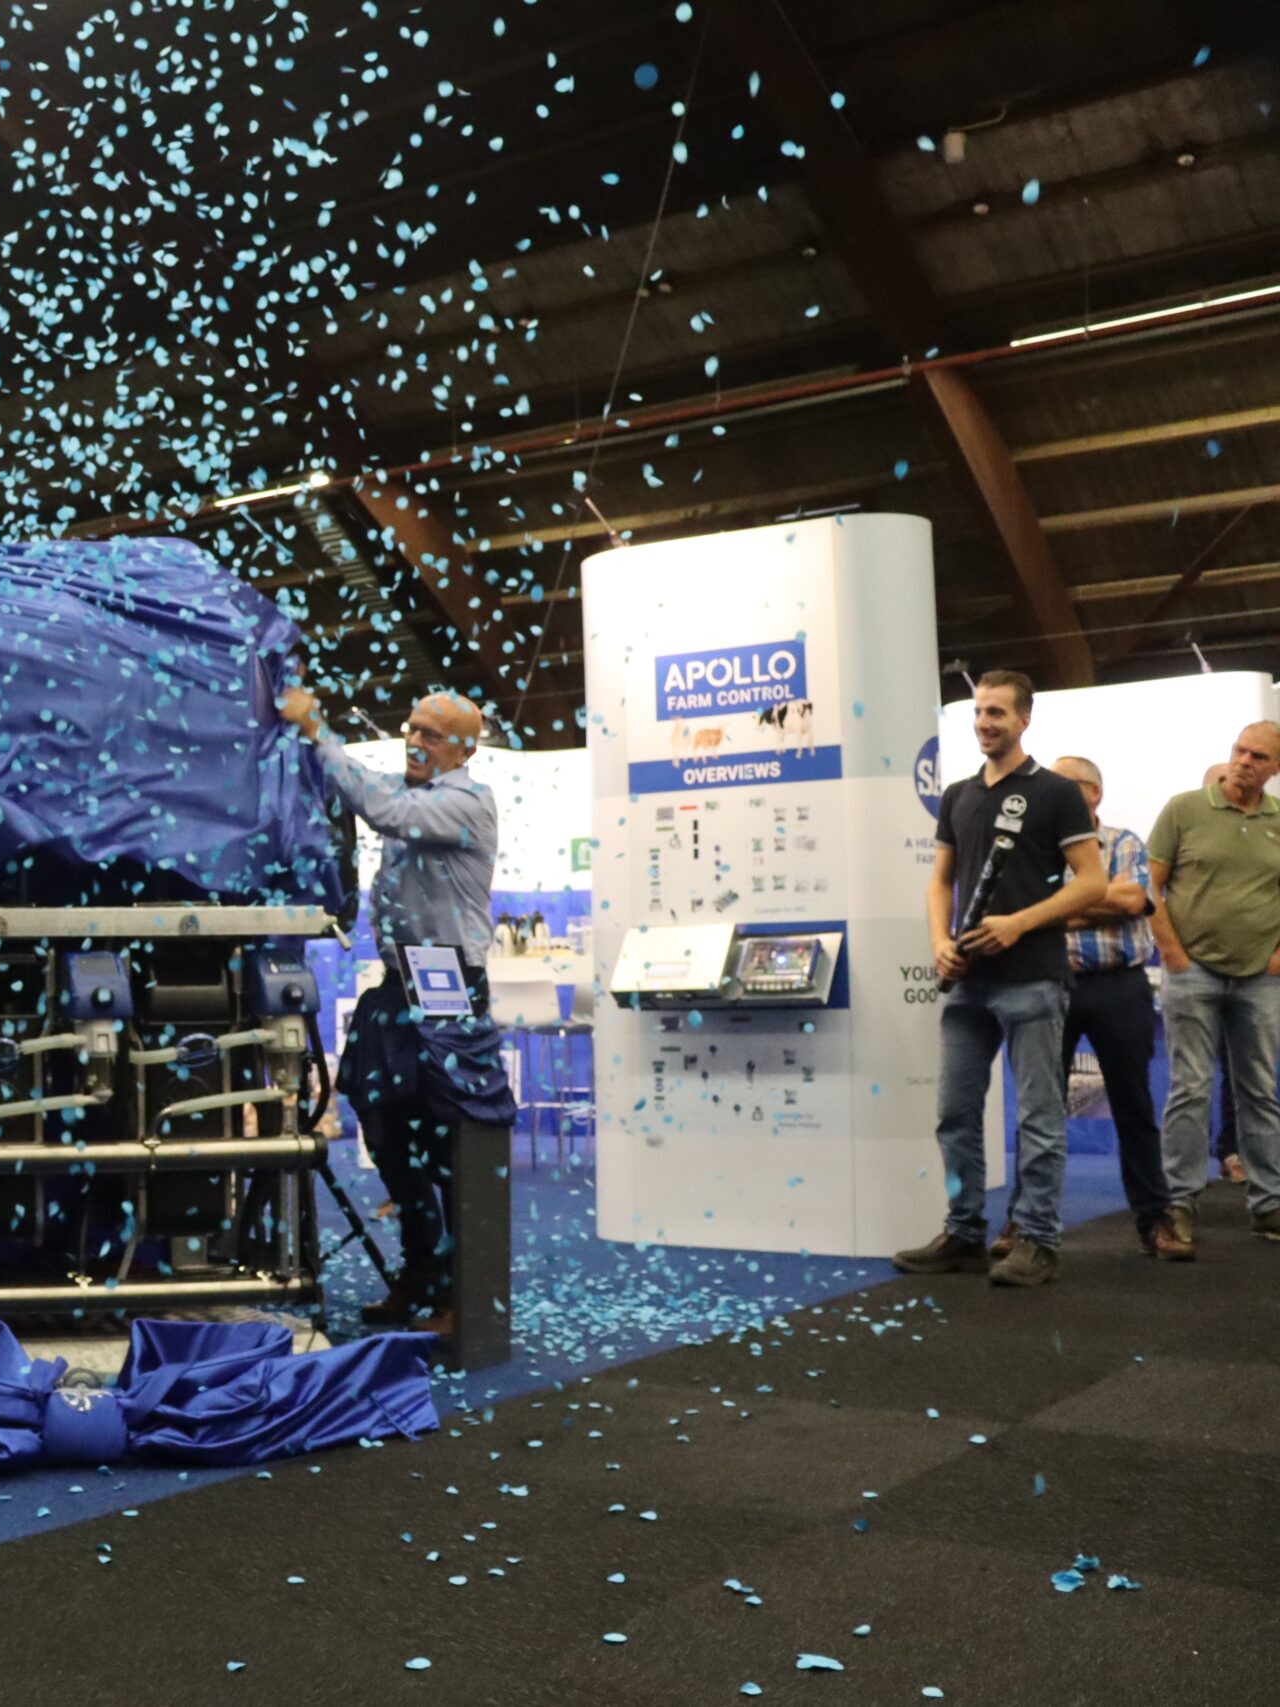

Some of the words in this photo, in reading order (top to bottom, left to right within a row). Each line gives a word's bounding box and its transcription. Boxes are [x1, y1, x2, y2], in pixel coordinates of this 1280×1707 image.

[664, 650, 796, 692] APOLLO
[667, 692, 712, 711] FARM
[717, 684, 794, 706] CONTROL
[683, 761, 781, 785] OVERVIEWS
[915, 838, 935, 848] HEA
[916, 854, 937, 864] FAR
[900, 966, 939, 981] YOU
[904, 988, 938, 1004] GOO
